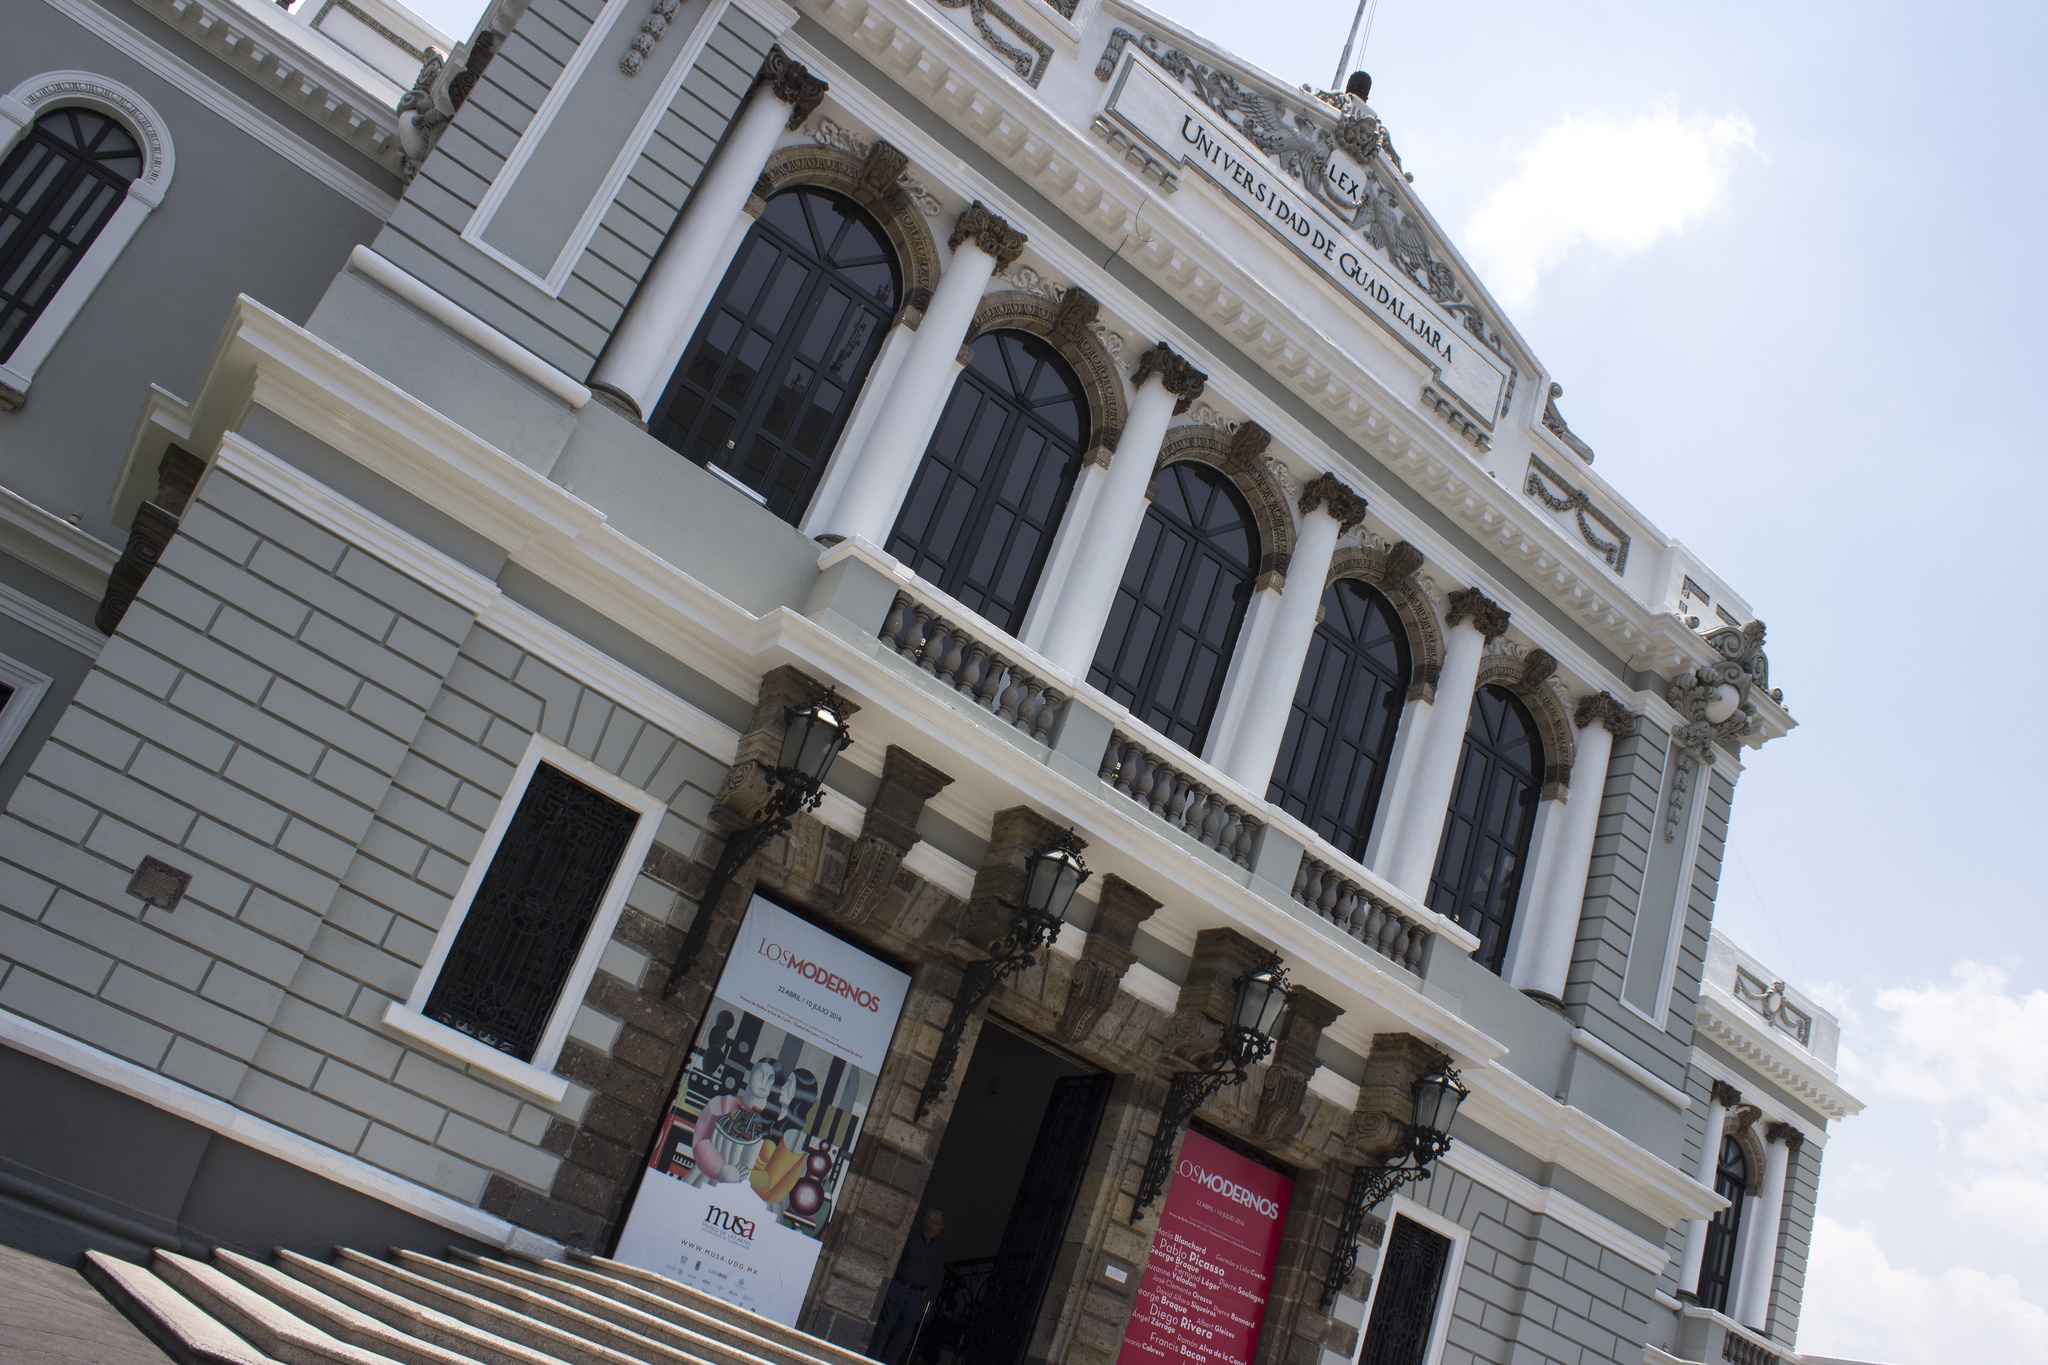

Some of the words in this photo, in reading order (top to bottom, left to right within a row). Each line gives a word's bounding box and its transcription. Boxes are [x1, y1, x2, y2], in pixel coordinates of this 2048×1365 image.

[1328, 163, 1359, 201] LEX
[1181, 114, 1311, 237] UNIVERSIDAD
[1311, 229, 1336, 261] DE
[1339, 252, 1452, 363] GUADALAJARA
[777, 985, 785, 993] 22
[785, 989, 801, 1002] ABRIL
[805, 999, 813, 1007] 10
[812, 1002, 829, 1015] JULIO
[829, 1011, 842, 1023] 2016
[702, 1222, 720, 1233] MUSEO
[728, 1233, 738, 1241] LAS
[737, 1236, 751, 1247] ARTES
[704, 1204, 756, 1240] musa
[680, 1238, 759, 1276] WWW.MUSA.UDG.MX
[1160, 1238, 1187, 1260] Pablo
[1189, 1251, 1225, 1276] Picasso
[1174, 1234, 1207, 1254] Blanchard
[1174, 1265, 1201, 1282] Fernand
[1201, 1276, 1220, 1292] Léger
[1175, 1256, 1200, 1274] Braque
[1250, 1268, 1266, 1280] Cueto
[1152, 1274, 1165, 1284] José
[1166, 1279, 1192, 1296] Clemente
[1192, 1291, 1212, 1305] Orozco
[1172, 1272, 1197, 1288] Valadon
[1220, 1278, 1237, 1292] Pierre
[1238, 1286, 1264, 1304] Soulages
[1132, 1307, 1150, 1322] Ángel
[1138, 1288, 1160, 1302] eorge
[1160, 1295, 1188, 1314] Braque
[1156, 1285, 1173, 1298] David
[1172, 1294, 1190, 1306] Alfaro
[1190, 1300, 1216, 1318] Siqueiros
[1150, 1302, 1178, 1326] Diego
[1180, 1316, 1213, 1340] Rivera
[1196, 1317, 1214, 1330] Albert
[1214, 1324, 1235, 1339] Gleizes
[1213, 1304, 1230, 1318] Pierre
[1230, 1312, 1256, 1329] Bonnard
[1124, 1337, 1142, 1348] osario
[1142, 1342, 1165, 1358] Cabrera
[1150, 1331, 1179, 1352] Francis
[1180, 1344, 1206, 1364] Bacon
[1176, 1333, 1198, 1349] Ramón
[1198, 1343, 1213, 1355] Alva
[1213, 1348, 1222, 1358] de
[1222, 1352, 1228, 1361] la
